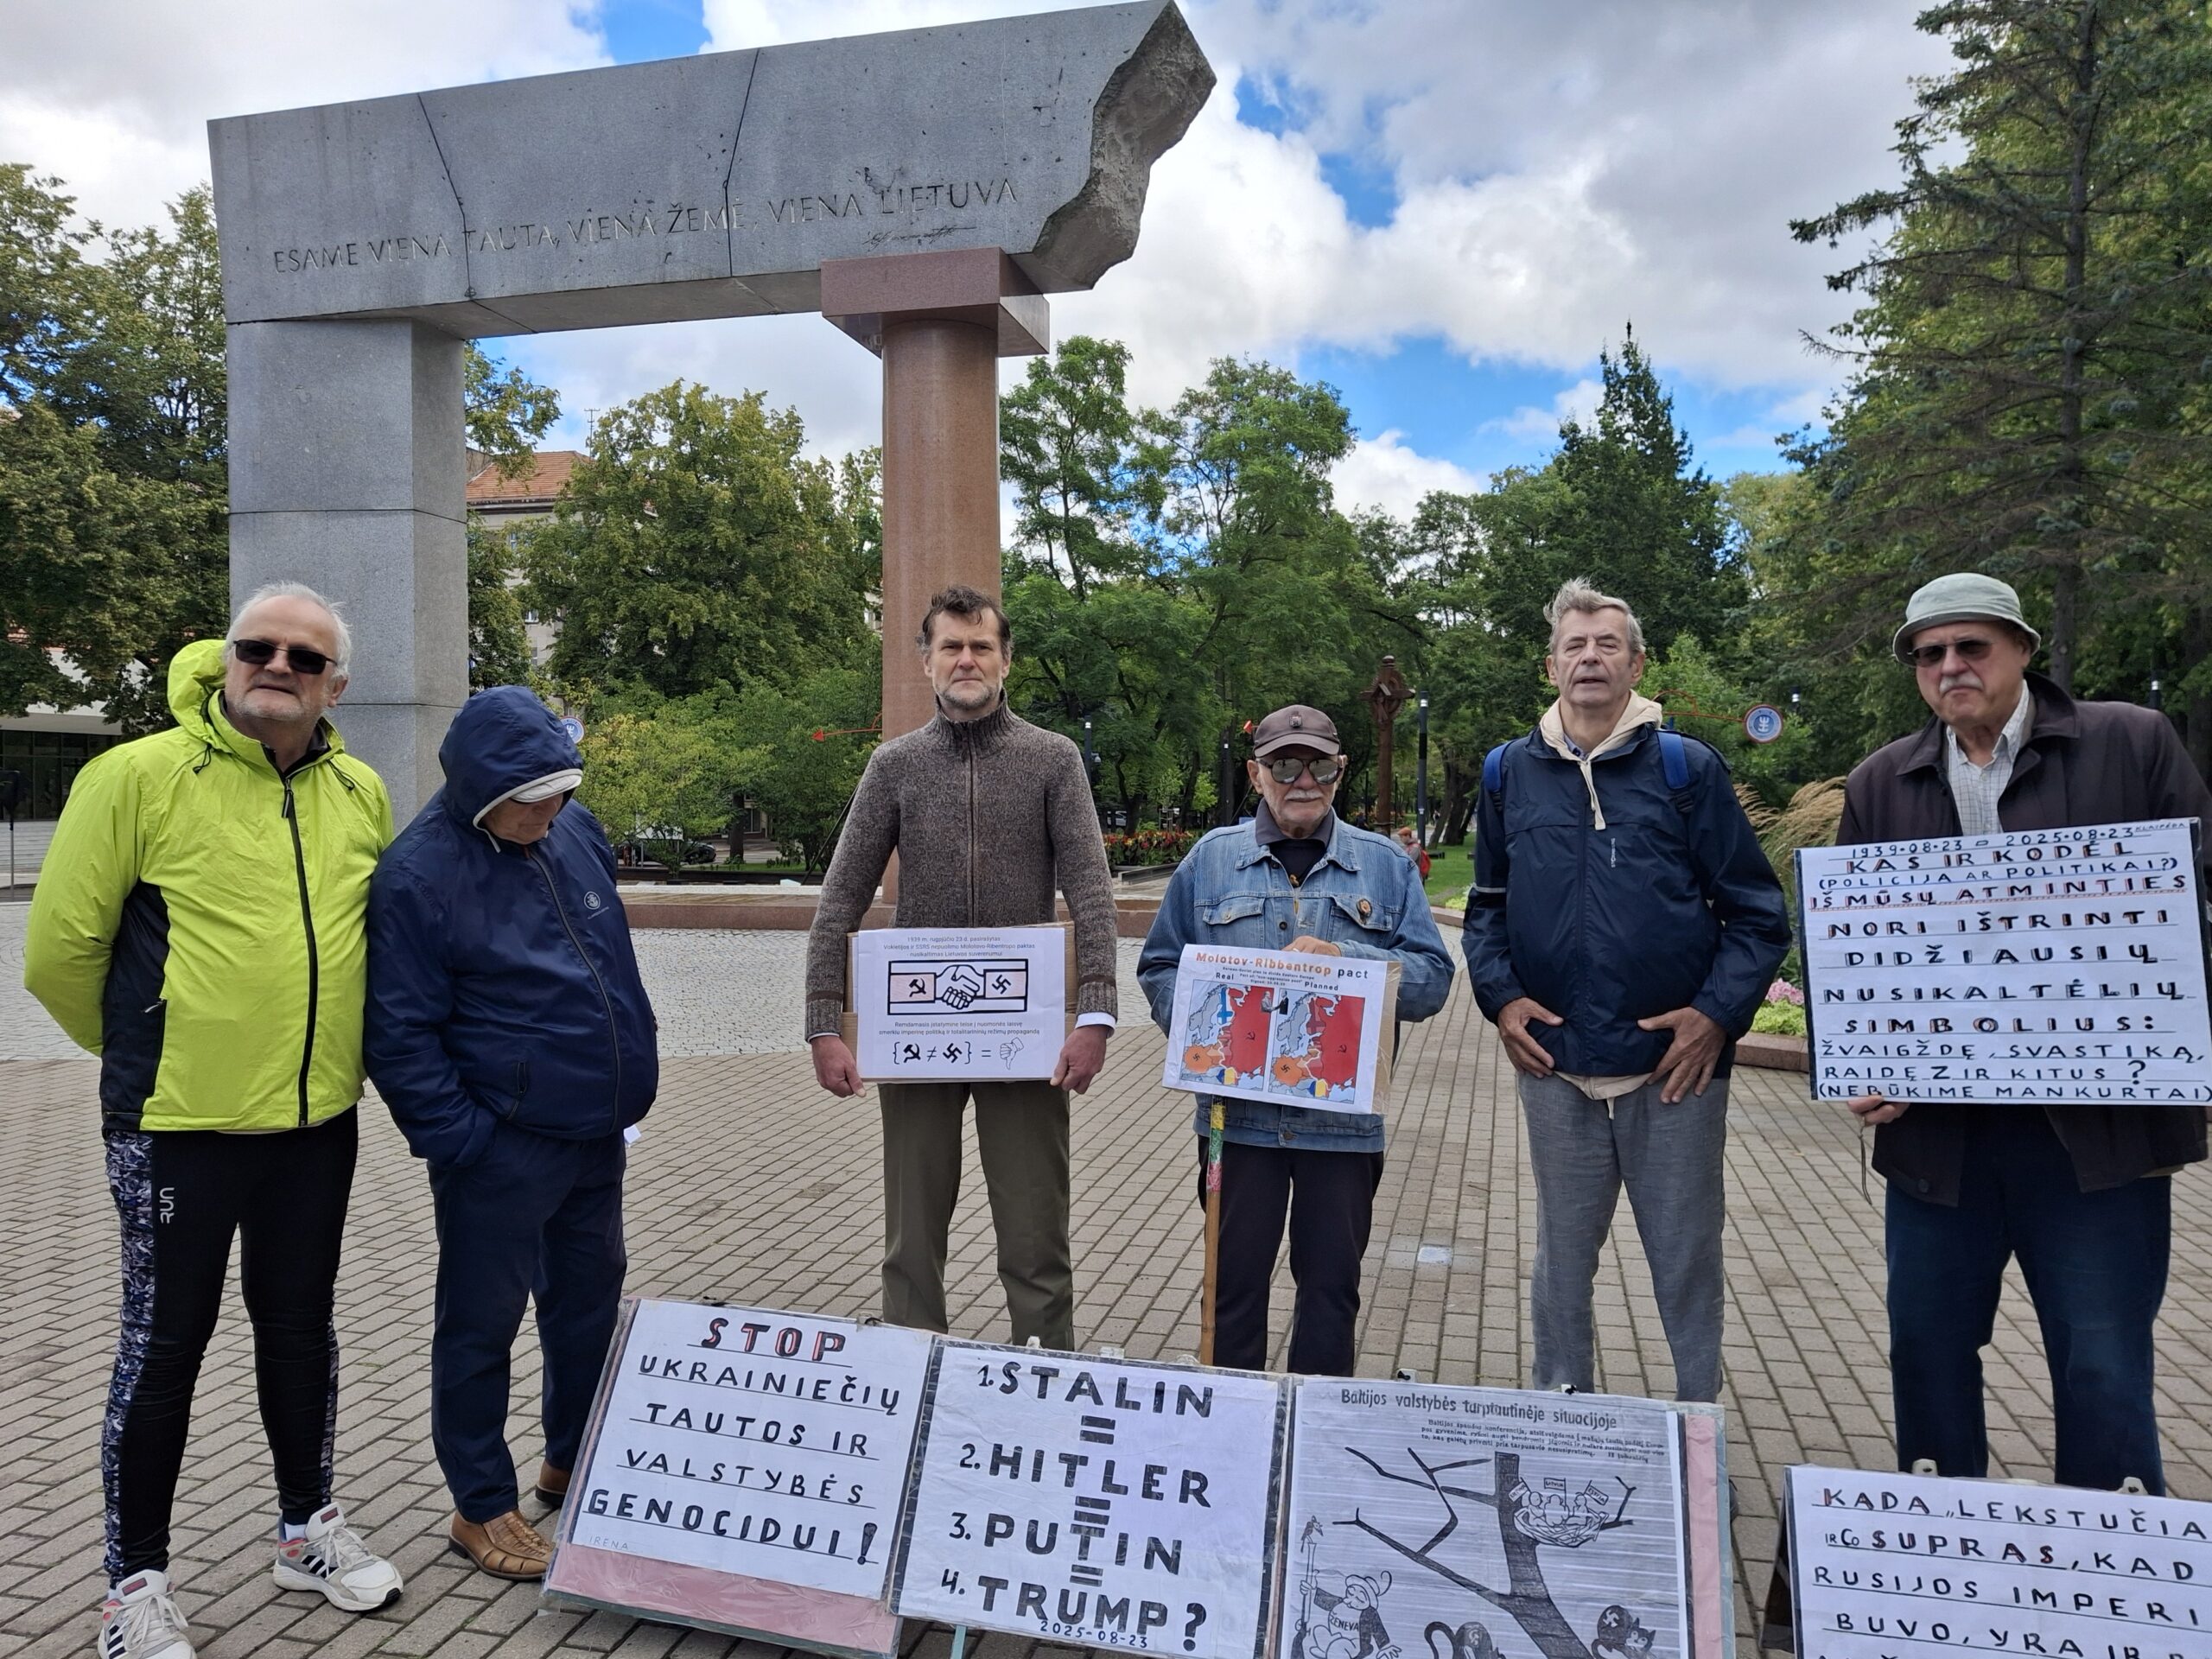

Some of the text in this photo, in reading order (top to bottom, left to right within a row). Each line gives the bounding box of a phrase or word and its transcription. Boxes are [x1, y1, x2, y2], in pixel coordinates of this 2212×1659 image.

[274, 244, 359, 273] ESAME
[367, 233, 451, 263] VIENA
[462, 224, 562, 254] TAUTA,
[567, 210, 656, 243] VIENA
[767, 194, 863, 225] VIENA
[880, 178, 1018, 215] LIETUVA
[1819, 857, 2178, 890] (POLICIJA AR POLITIKAI?)
[1847, 841, 2133, 874] KAS IR KODĖL
[1810, 874, 2186, 909] IŠ MŪSŲ ATMINTIES
[1827, 909, 2169, 939] NORI IŠTRINTI
[1195, 952, 1369, 979] Molotov-Ribbentrop pact
[1845, 944, 2158, 967] DIDŽIAUSIŲ
[1216, 972, 1235, 981] Real
[1305, 981, 1339, 992] Planned
[1823, 978, 2185, 1003] NUSIKALTĖLIŲ
[1845, 1015, 2154, 1033] SIMBOLIUS:
[1825, 1066, 1917, 1082] RAIDĘ
[1930, 1065, 1951, 1080] Z
[1964, 1068, 1991, 1080] IR
[159, 1186, 175, 1224] RUN
[701, 1317, 847, 1363] STOP
[639, 1354, 900, 1416] UKRAINIEČIŲ
[998, 1361, 1214, 1418] STALIN
[1341, 1388, 1388, 1408] Baltijos
[1395, 1392, 1457, 1413] valstybės
[1553, 1409, 1618, 1432] situacijoje
[645, 1402, 868, 1457] TAUTOS IR
[626, 1448, 864, 1504] VALSTYBĖS
[988, 1443, 1211, 1509] HITLER
[1823, 1487, 1930, 1516] KADA
[588, 1488, 880, 1566] GENOCIDUI!
[589, 1535, 629, 1550] IRENA
[983, 1512, 1182, 1576] PUTIN
[2094, 1551, 2195, 1580] KAD
[1814, 1567, 2199, 1626] RUSIJOS IMPERI
[1039, 1620, 1148, 1649] 2025-08-23
[1331, 1611, 1359, 1631] ŽENEVA
[1989, 1628, 2084, 1658] YRA
